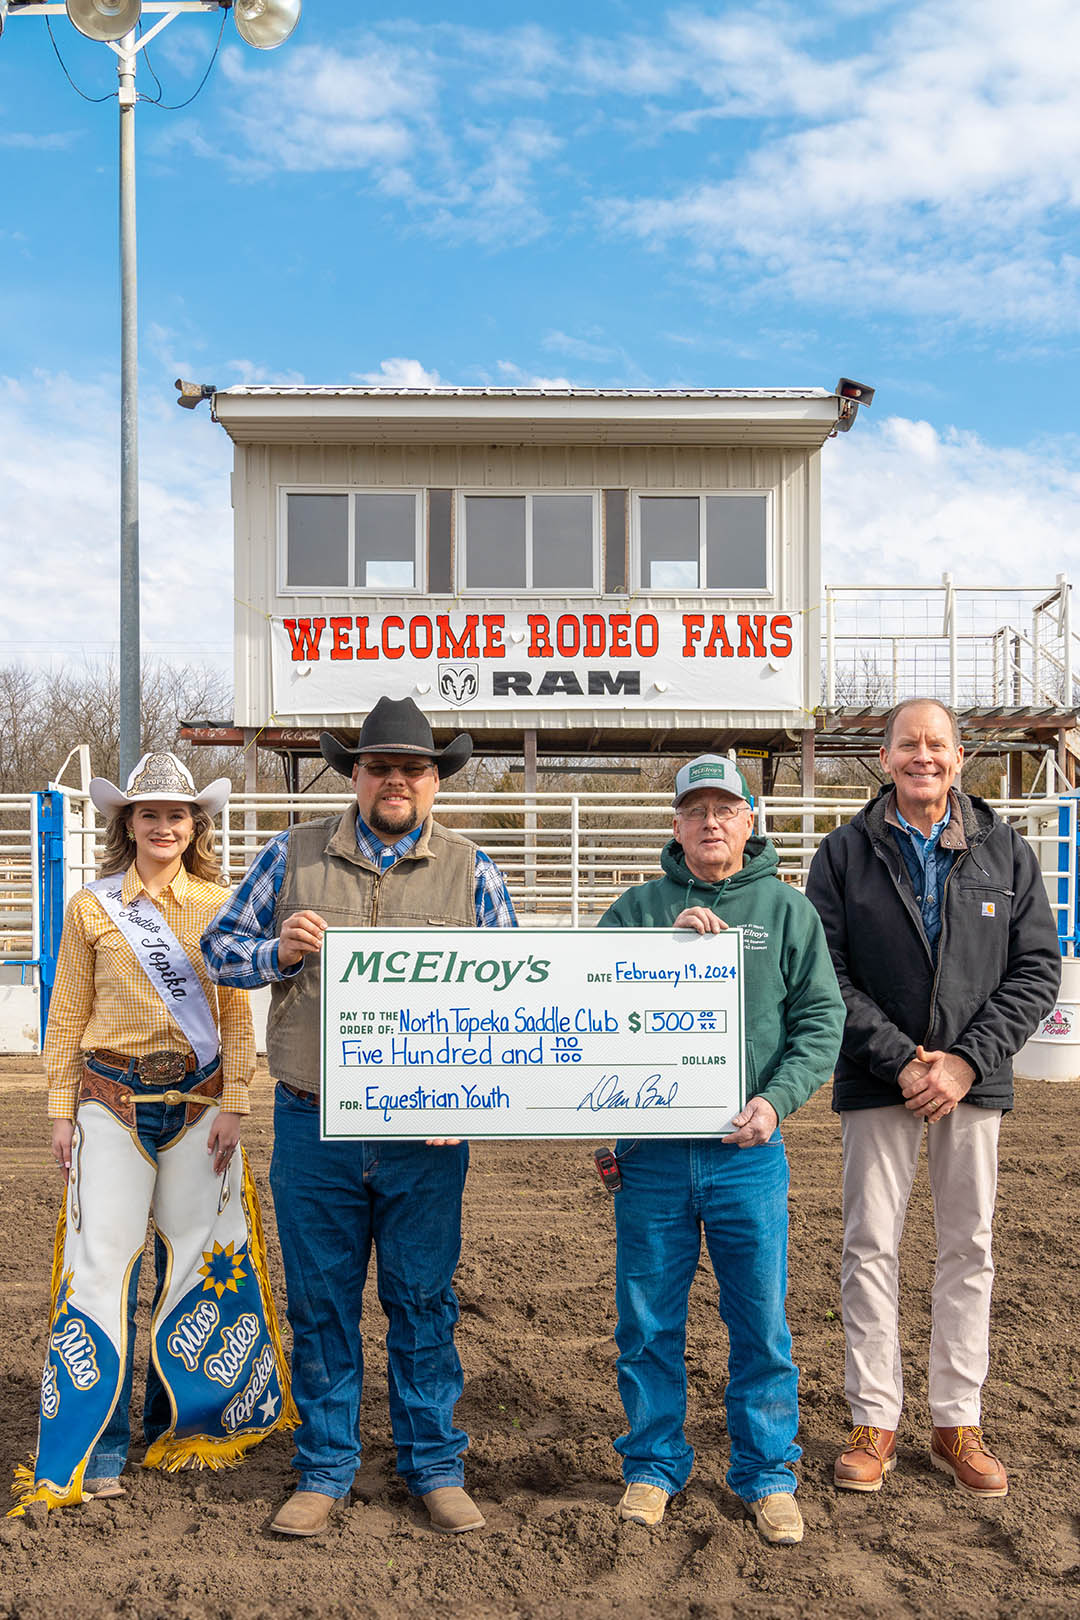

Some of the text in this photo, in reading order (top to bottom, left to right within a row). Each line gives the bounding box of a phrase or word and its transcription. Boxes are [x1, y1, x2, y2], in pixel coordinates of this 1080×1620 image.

[283, 614, 793, 661] WELCOME RODEO FANS
[493, 670, 641, 697] RAM
[119, 910, 161, 934] Rodeo
[141, 937, 187, 1002] Topeka
[339, 951, 551, 992] McElroy's
[587, 973, 612, 983] DATE
[615, 961, 680, 988] February
[340, 1012, 398, 1021] PAY TO THE
[340, 1025, 394, 1034] ORDER OF:
[400, 1006, 619, 1042] North Topeka Saddle Club
[628, 1011, 642, 1033] $
[651, 1012, 695, 1032] 500
[342, 1035, 543, 1065] Five Hundred and
[556, 1053, 582, 1063] 100
[682, 1056, 727, 1065] DOLLARS
[340, 1101, 362, 1110] FOR:
[366, 1084, 510, 1122] Equestrian Youth
[170, 1302, 217, 1370] Miss
[209, 1315, 257, 1385] Rodeo
[53, 1321, 98, 1387] Miss
[42, 1368, 58, 1415] deo
[224, 1346, 275, 1430] Topeka
